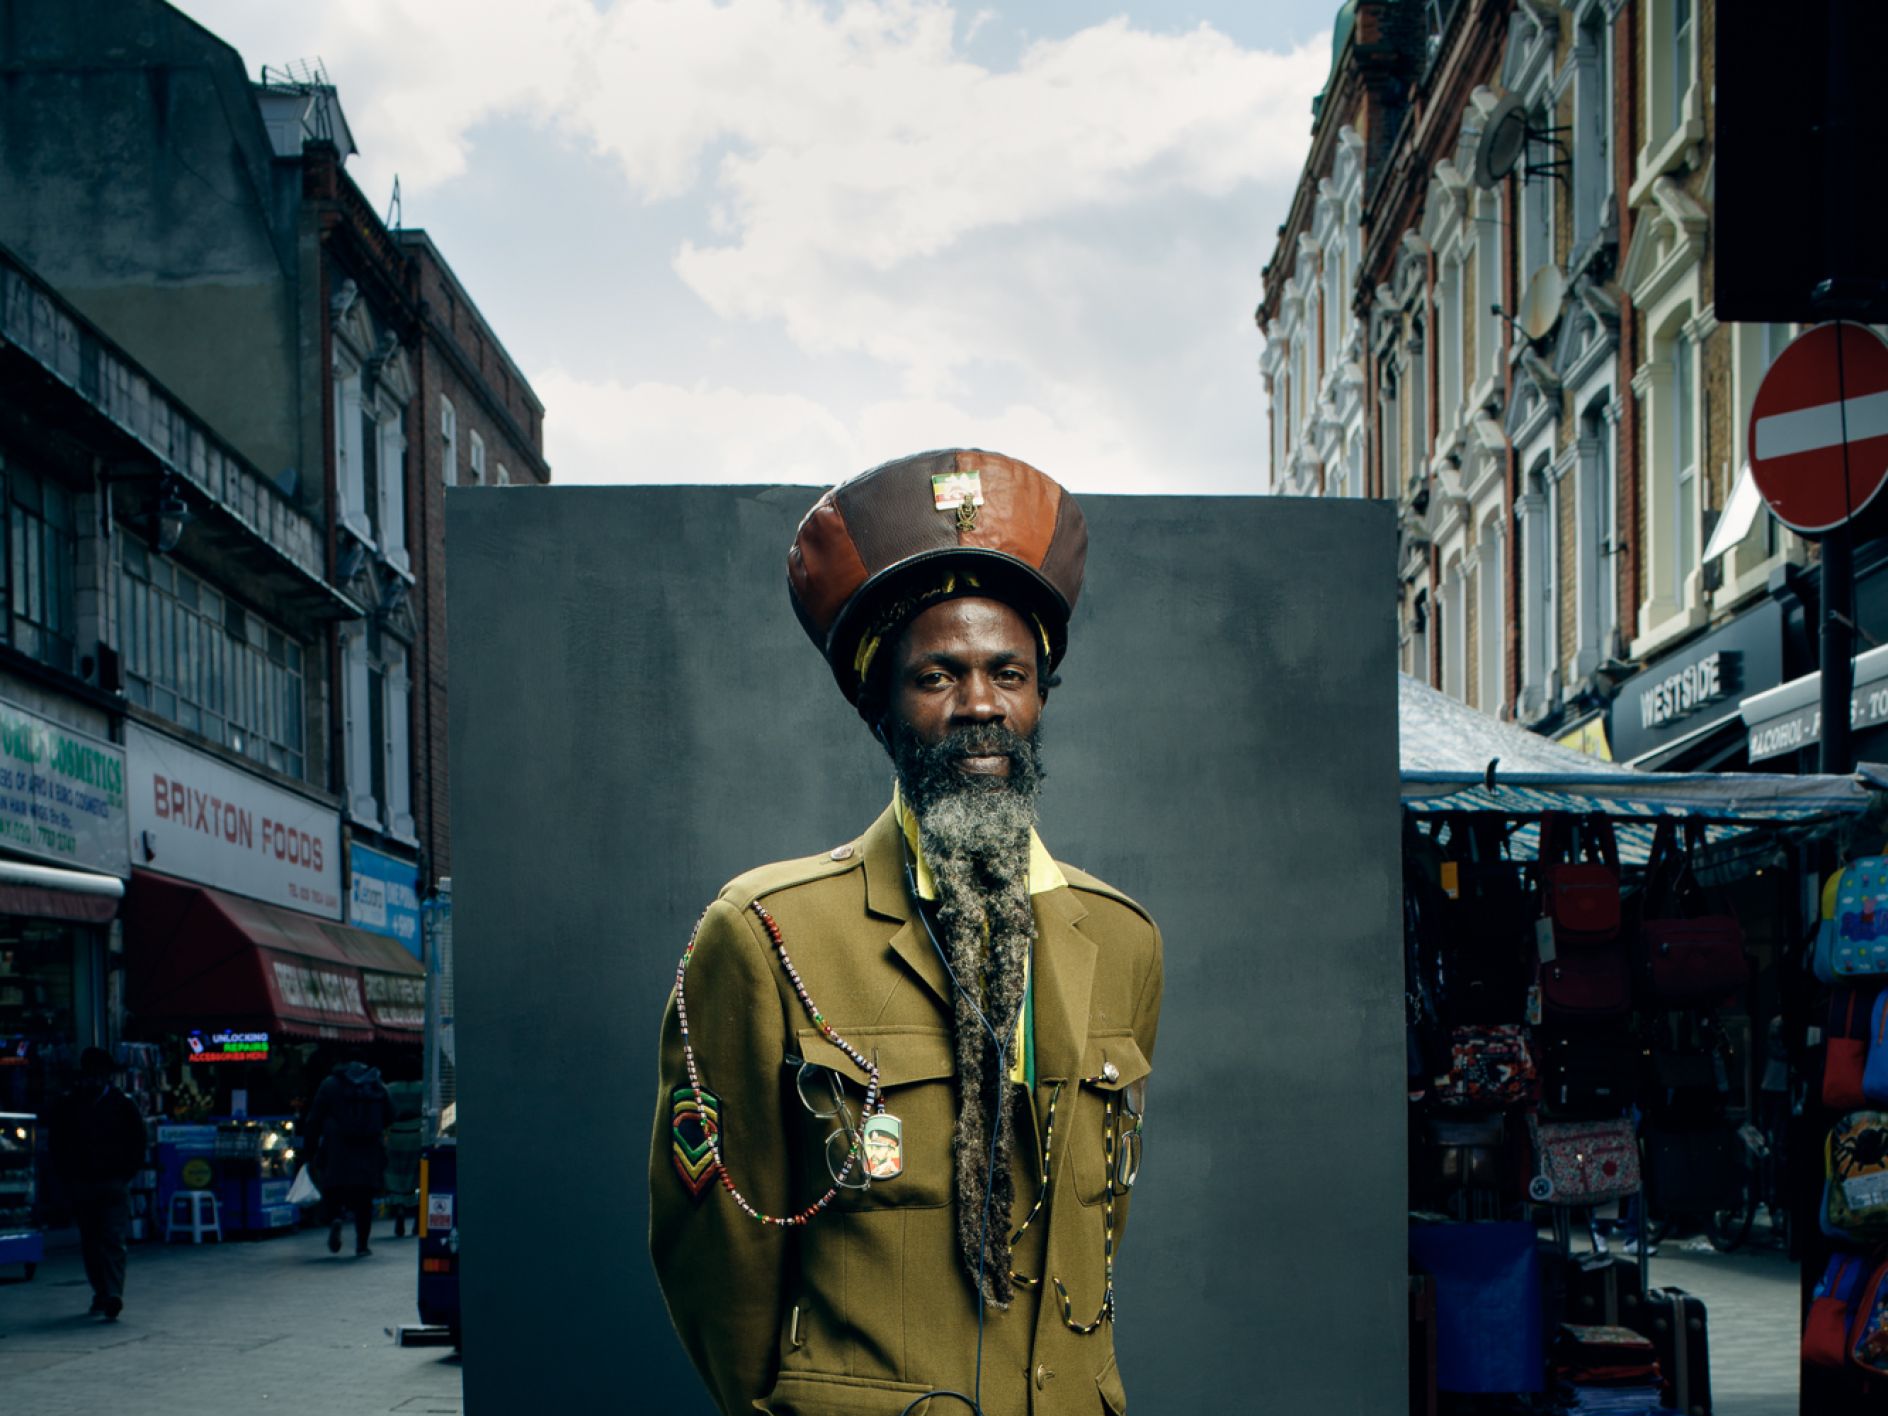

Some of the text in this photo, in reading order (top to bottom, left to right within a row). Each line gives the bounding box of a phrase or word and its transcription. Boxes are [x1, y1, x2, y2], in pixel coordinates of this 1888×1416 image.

[1640, 652, 1720, 729] WESTSIDE
[0, 719, 122, 795] ORLD COSMETICS
[1751, 718, 1803, 755] ALCOHOL
[154, 773, 323, 873] BRIXTON FOODS
[212, 1032, 268, 1044] UNLOCKING
